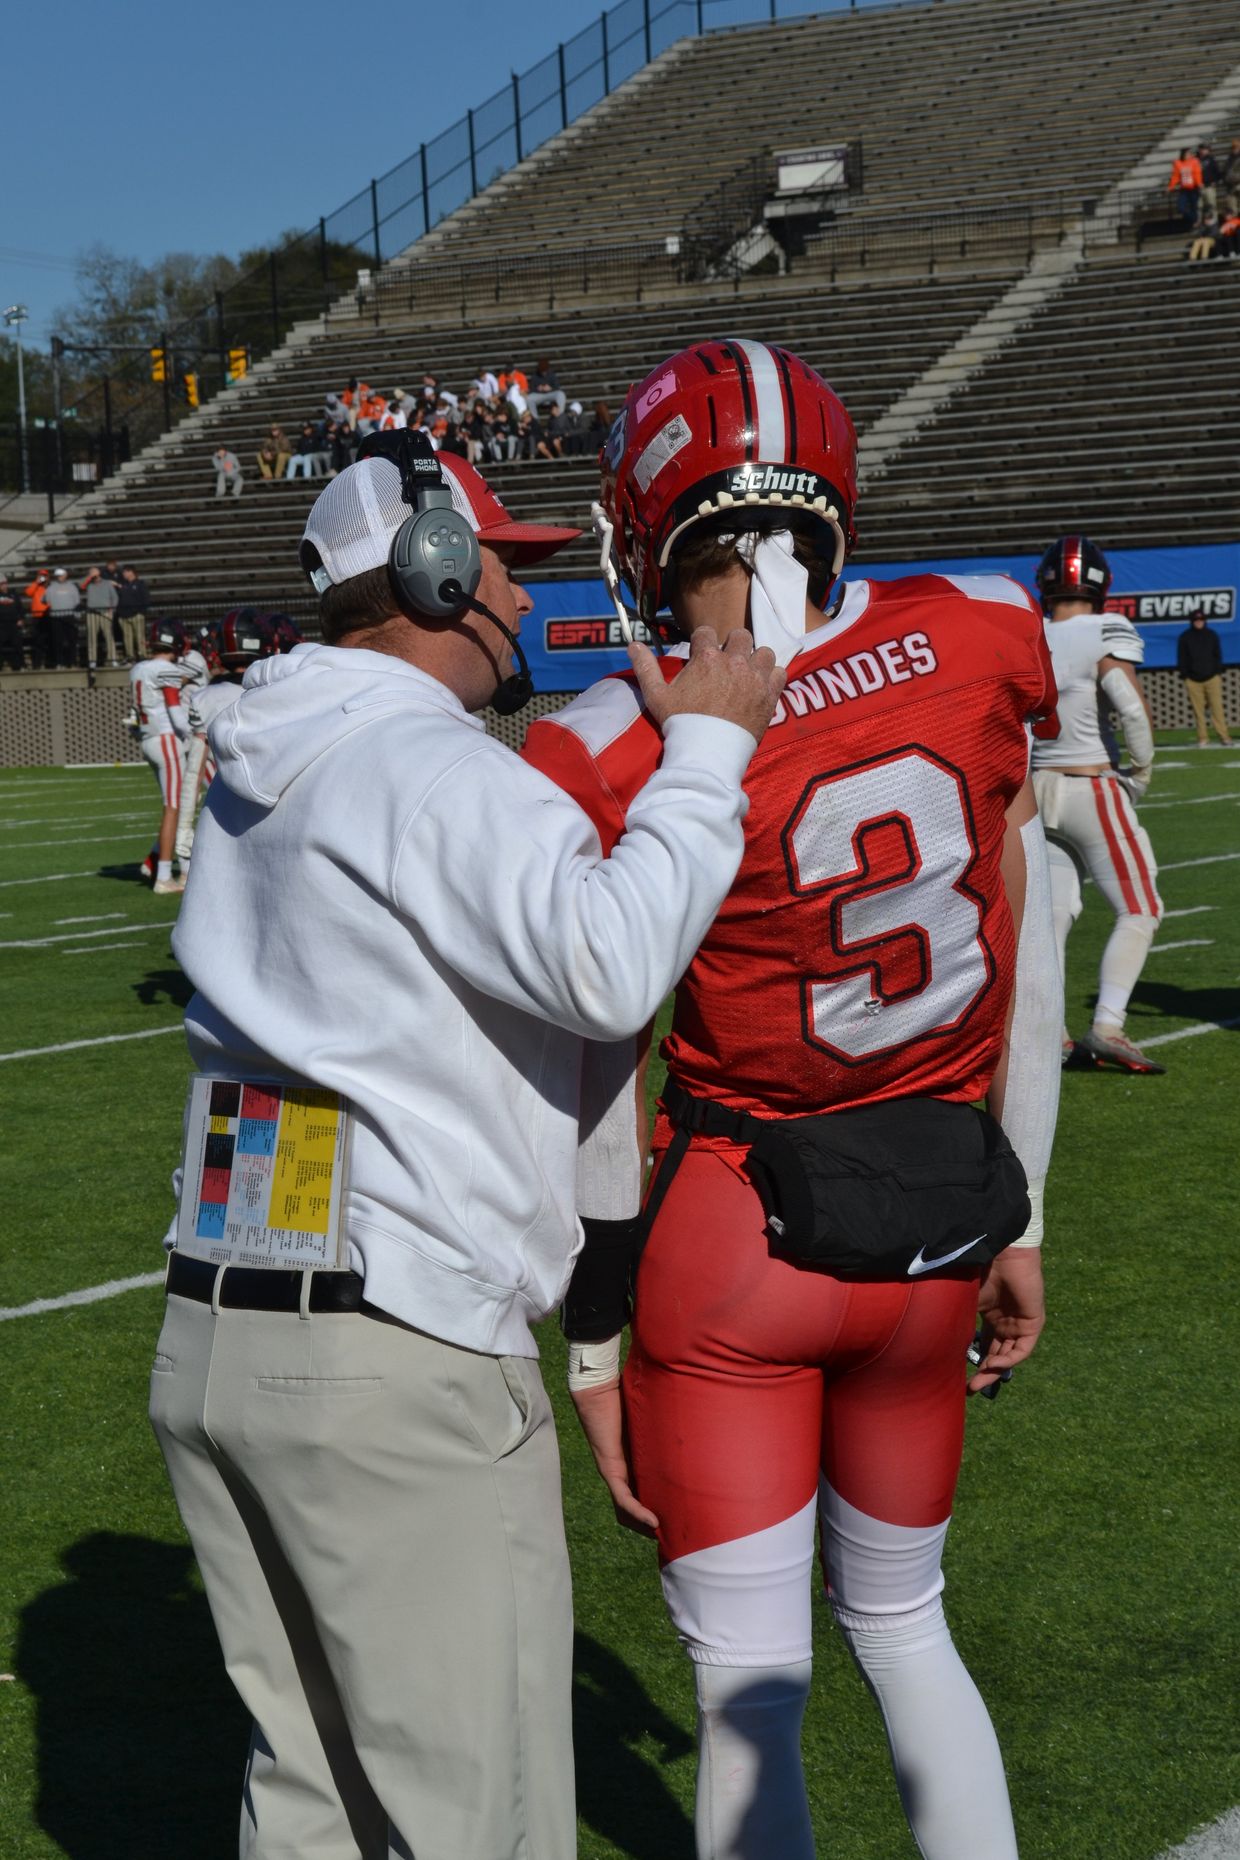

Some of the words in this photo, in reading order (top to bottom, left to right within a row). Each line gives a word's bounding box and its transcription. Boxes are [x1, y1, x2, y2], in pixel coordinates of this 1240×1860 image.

[730, 466, 818, 494] schutt
[1140, 592, 1231, 618] EVENTS
[550, 622, 606, 645] ESPN
[768, 631, 938, 727] WNDES
[782, 744, 996, 1066] 3
